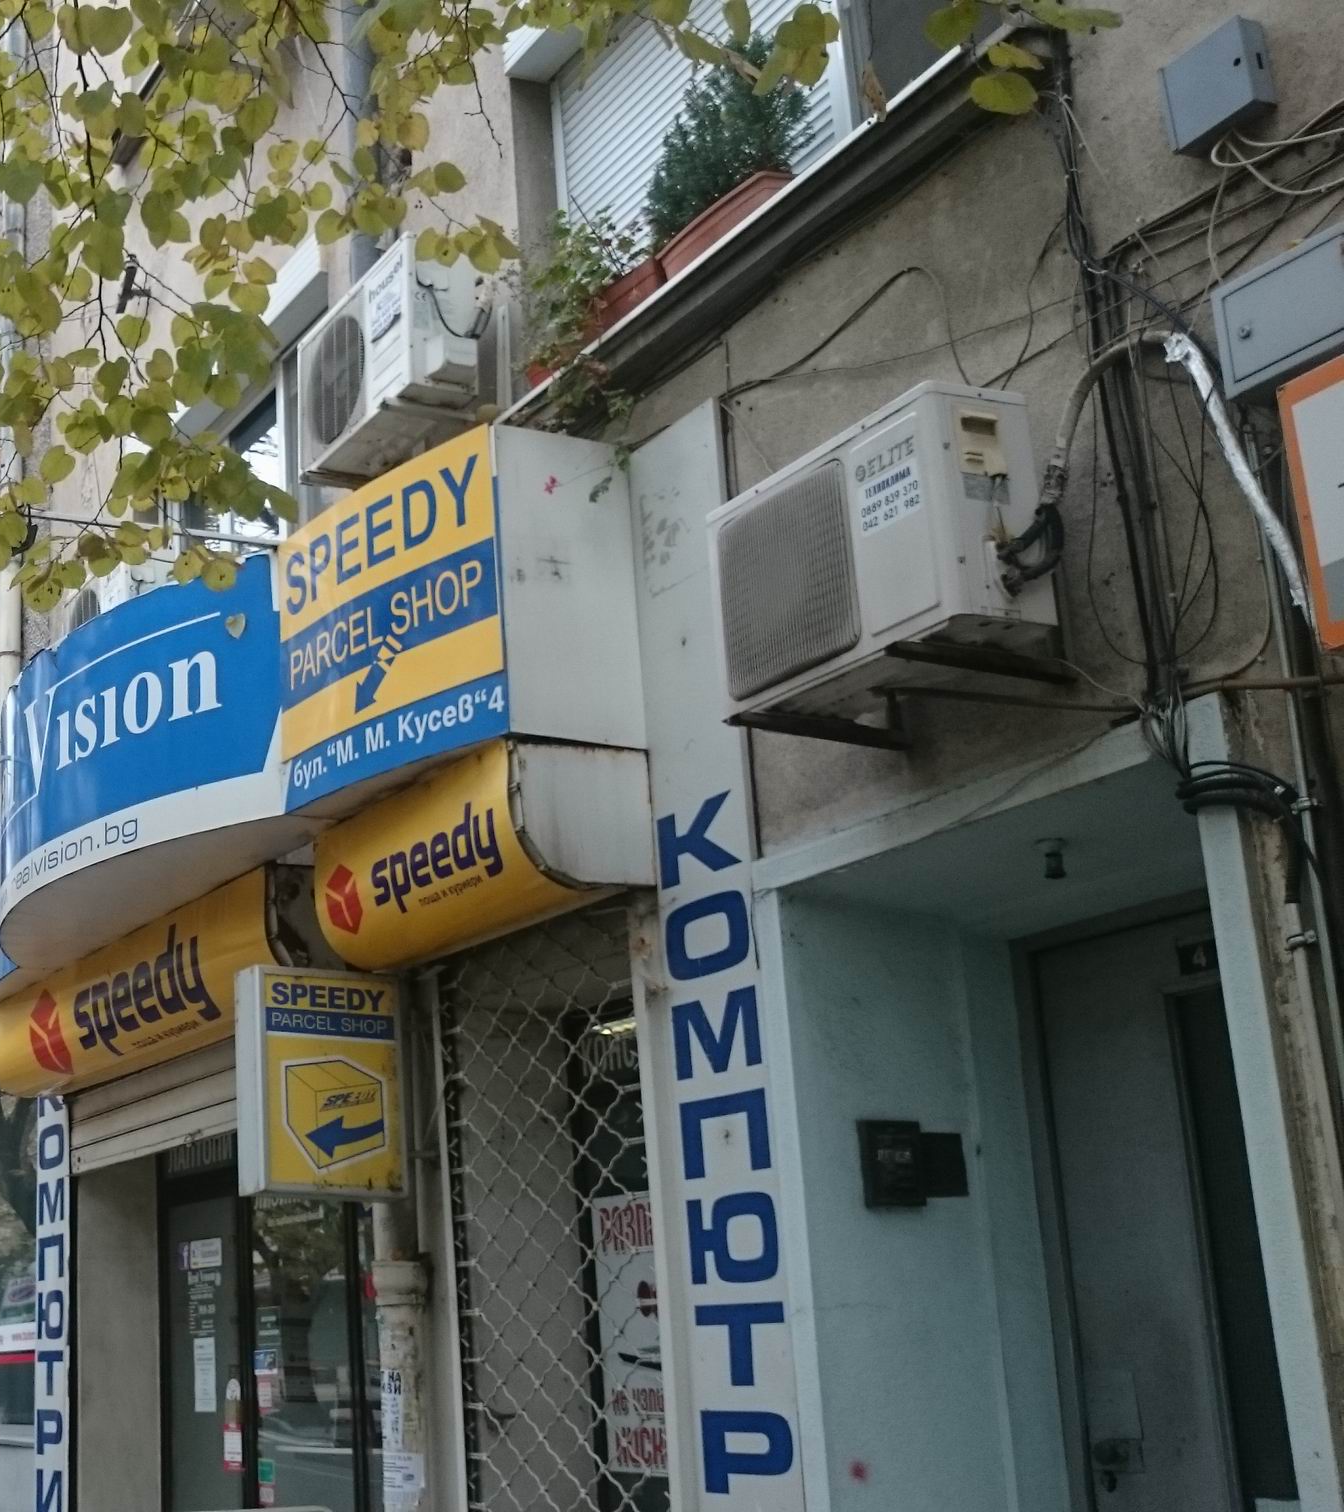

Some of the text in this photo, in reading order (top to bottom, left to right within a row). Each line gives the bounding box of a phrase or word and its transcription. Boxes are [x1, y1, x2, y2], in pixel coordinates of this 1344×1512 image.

[866, 435, 915, 479] ELITE
[286, 453, 478, 616] SPEEDY
[861, 499, 882, 518] 0889
[862, 516, 879, 531] 042
[904, 494, 920, 509] 982
[290, 559, 482, 691] PARCEL SHOP
[293, 754, 328, 790] бул.
[365, 722, 391, 756] М.
[371, 801, 504, 914] speedy
[73, 923, 222, 1057] speedy
[271, 981, 385, 1012] SPEEDY
[271, 1012, 389, 1035] PARCEL SHOP
